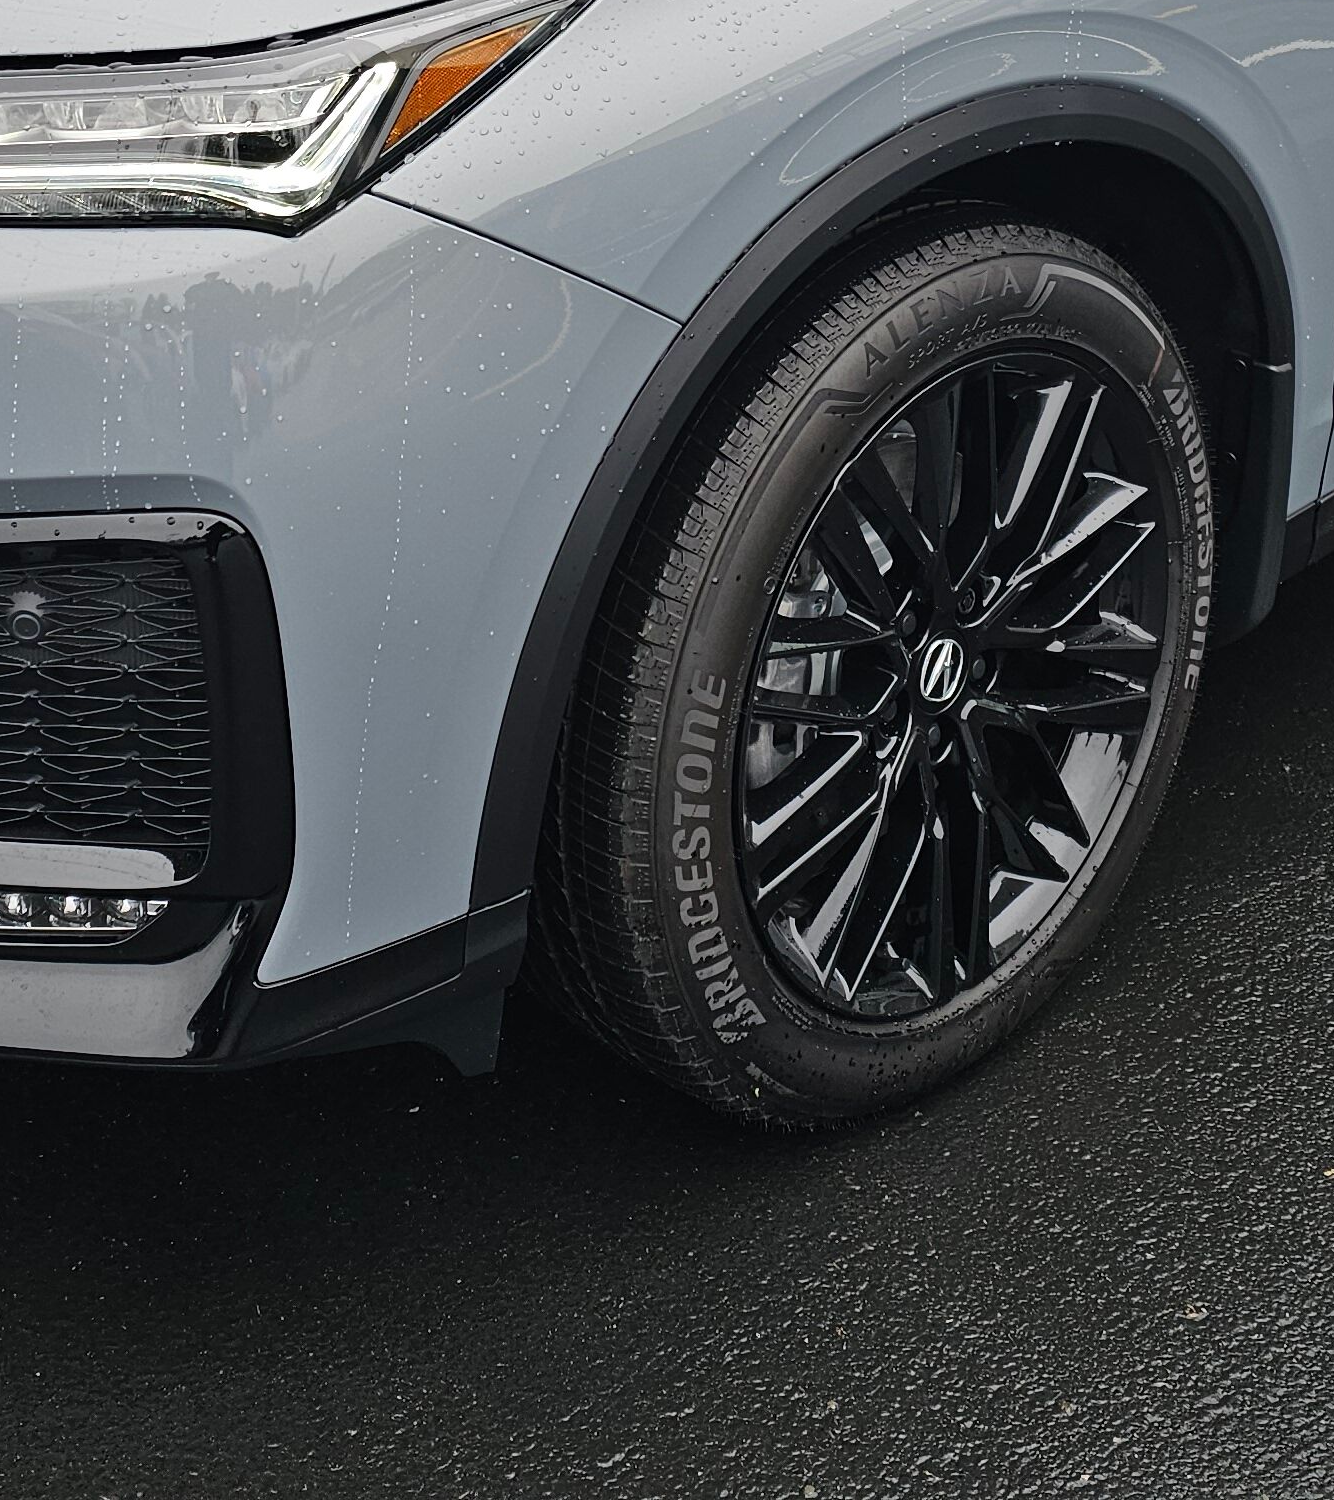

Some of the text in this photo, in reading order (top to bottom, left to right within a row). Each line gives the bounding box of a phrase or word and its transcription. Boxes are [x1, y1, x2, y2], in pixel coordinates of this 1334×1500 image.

[864, 265, 1022, 380] ALENZA
[908, 328, 955, 370] SPORT
[1163, 368, 1212, 691] BRIDGESTONE
[672, 669, 767, 1045] BRIDGESTONE
